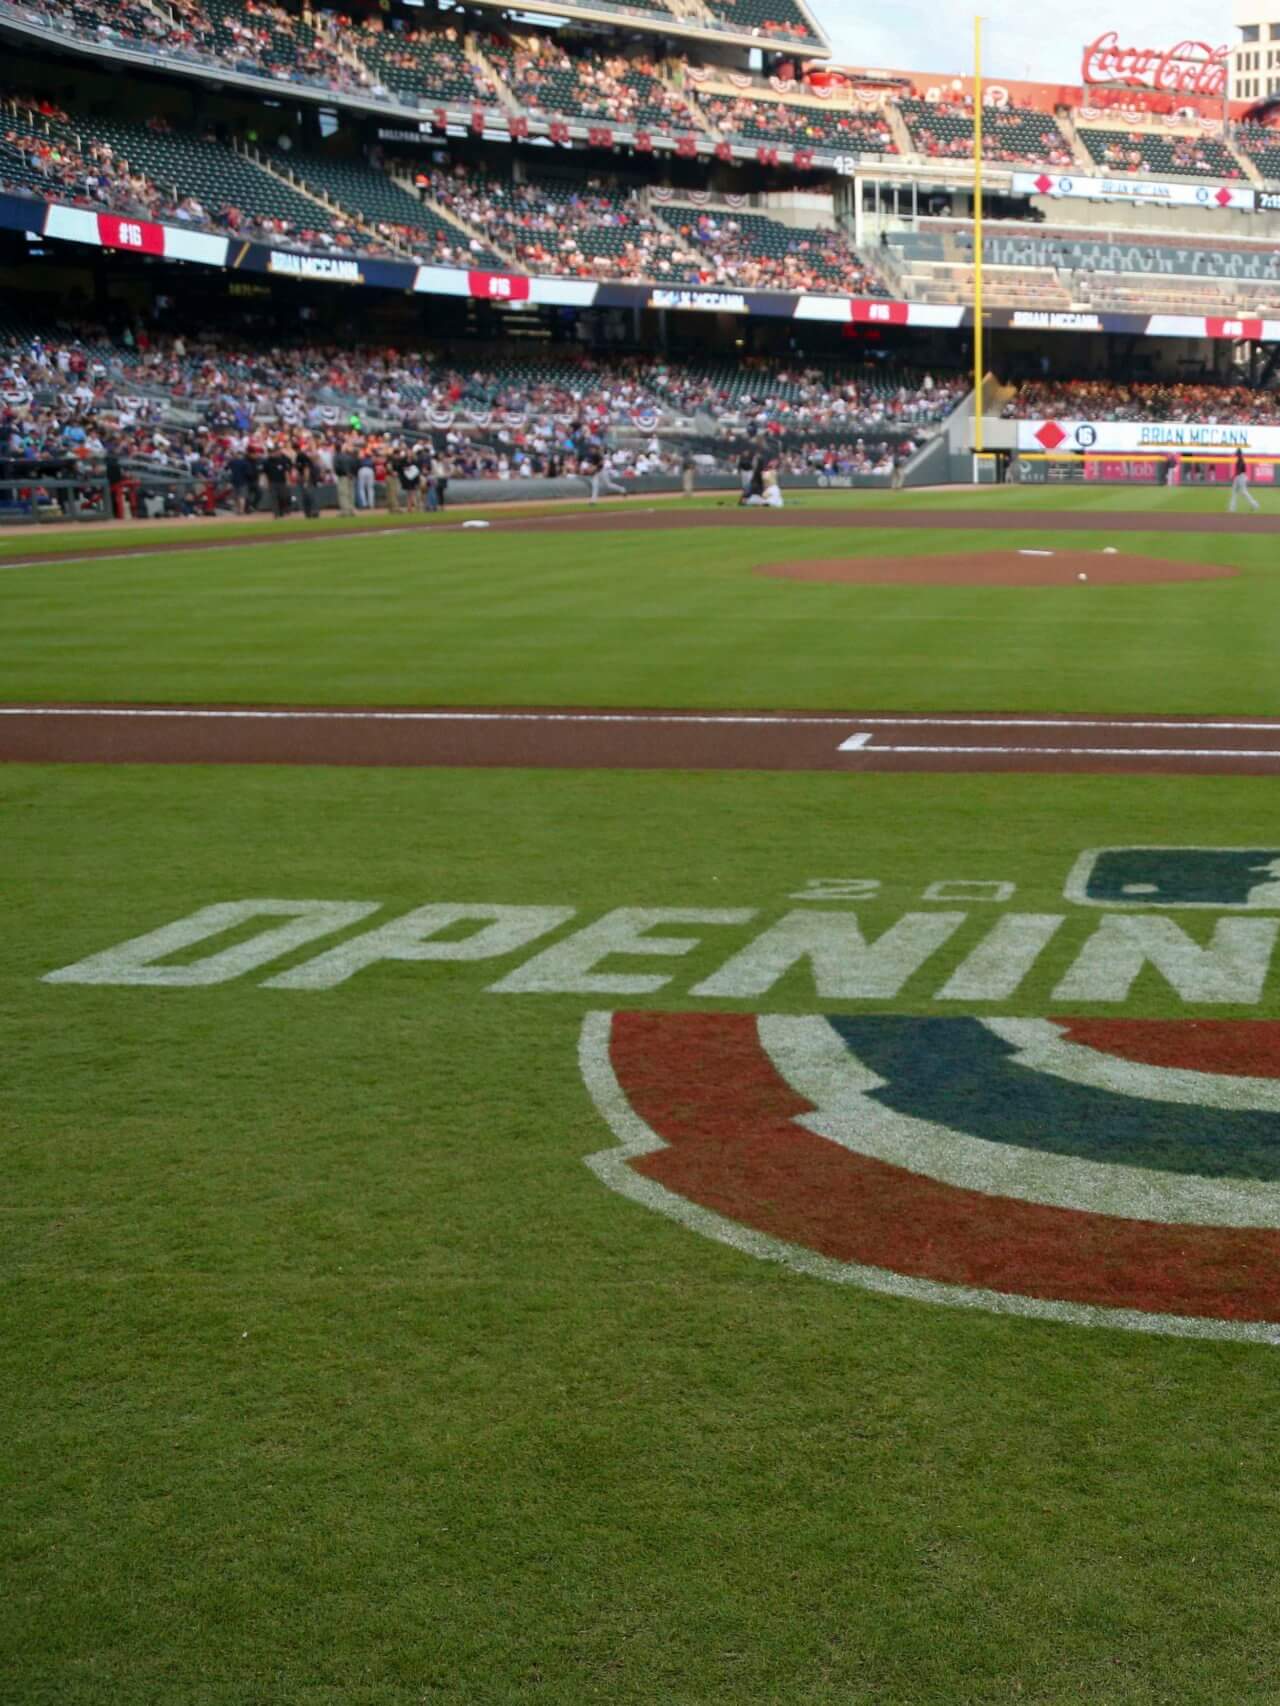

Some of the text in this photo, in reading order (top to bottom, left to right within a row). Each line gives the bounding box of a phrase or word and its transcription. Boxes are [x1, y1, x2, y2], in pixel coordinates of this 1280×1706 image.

[833, 156, 855, 175] 42
[119, 223, 142, 247] #16
[271, 251, 359, 280] BRIAN MCCANN
[1141, 426, 1249, 445] BRIAN MCCANN
